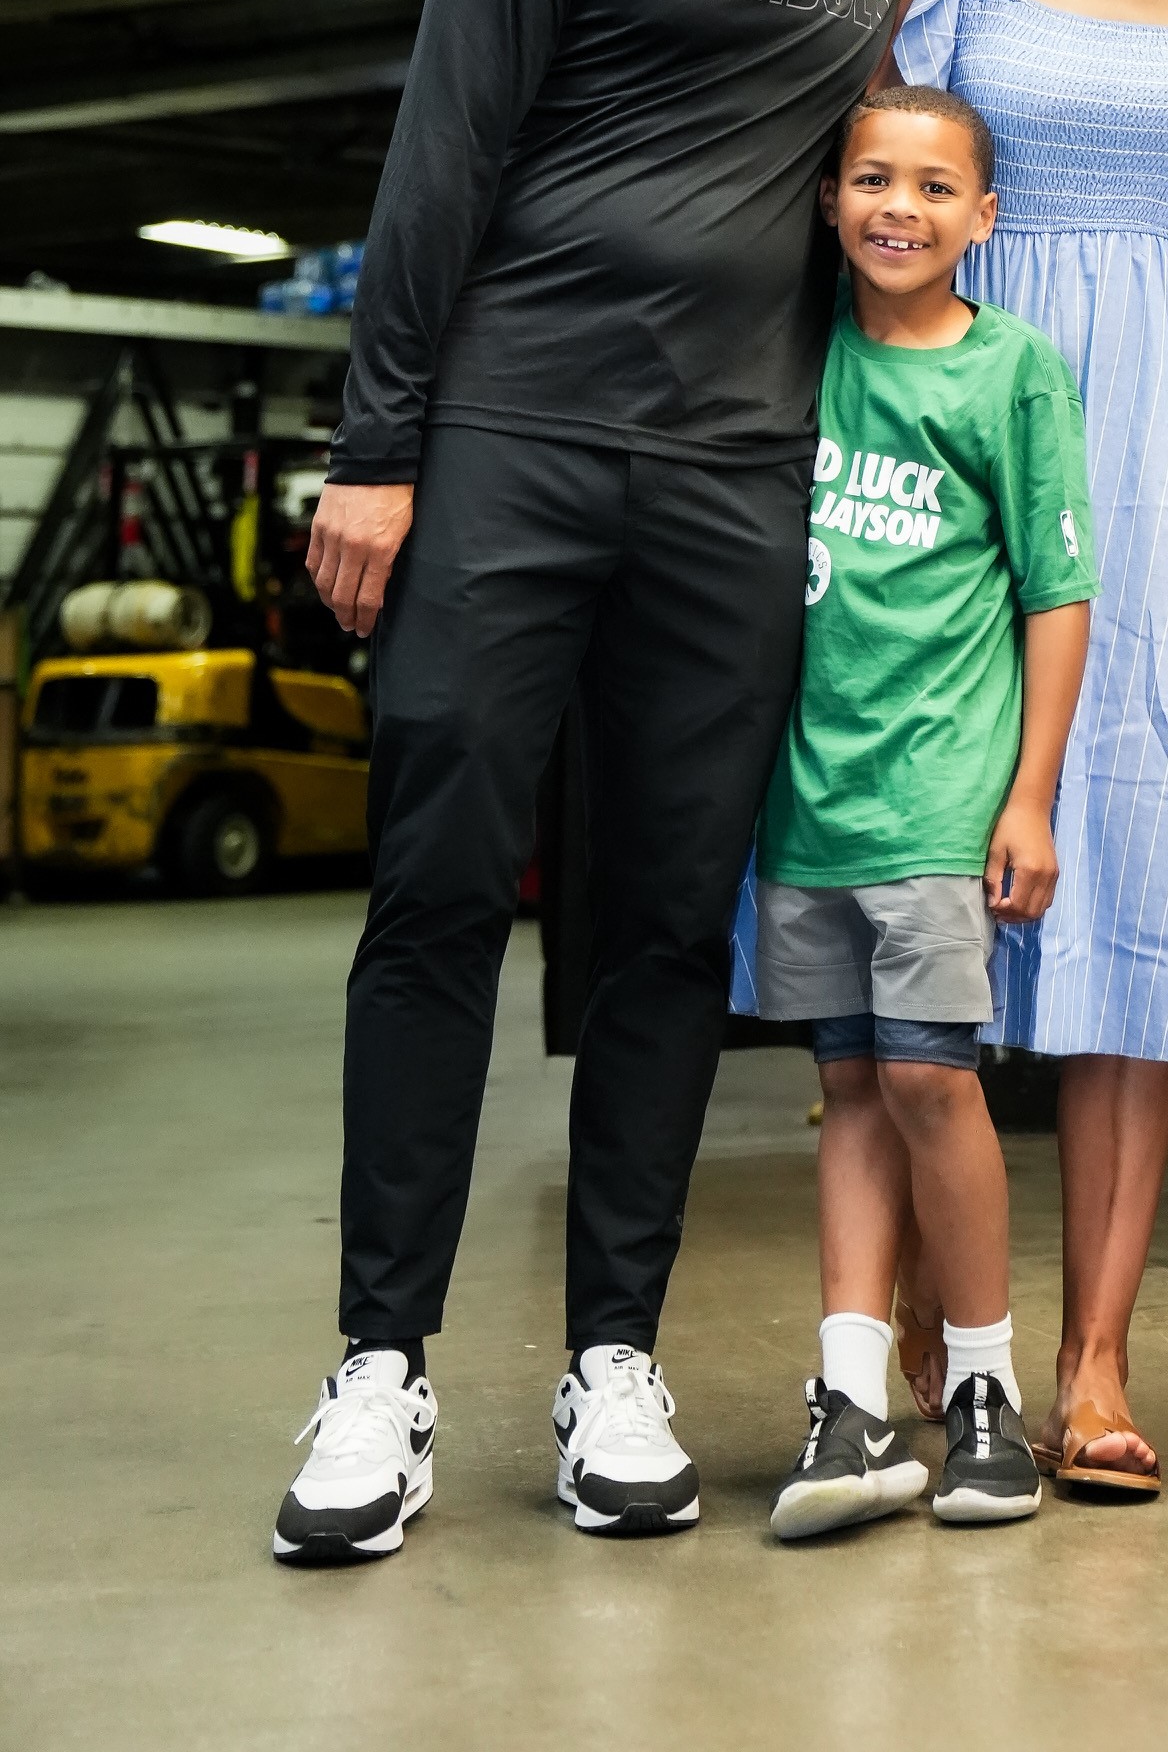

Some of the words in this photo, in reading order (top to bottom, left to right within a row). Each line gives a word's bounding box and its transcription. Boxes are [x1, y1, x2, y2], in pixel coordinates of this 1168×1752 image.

[845, 450, 946, 513] LUCK
[810, 490, 941, 549] JAYSON
[616, 1348, 639, 1358] NIKE
